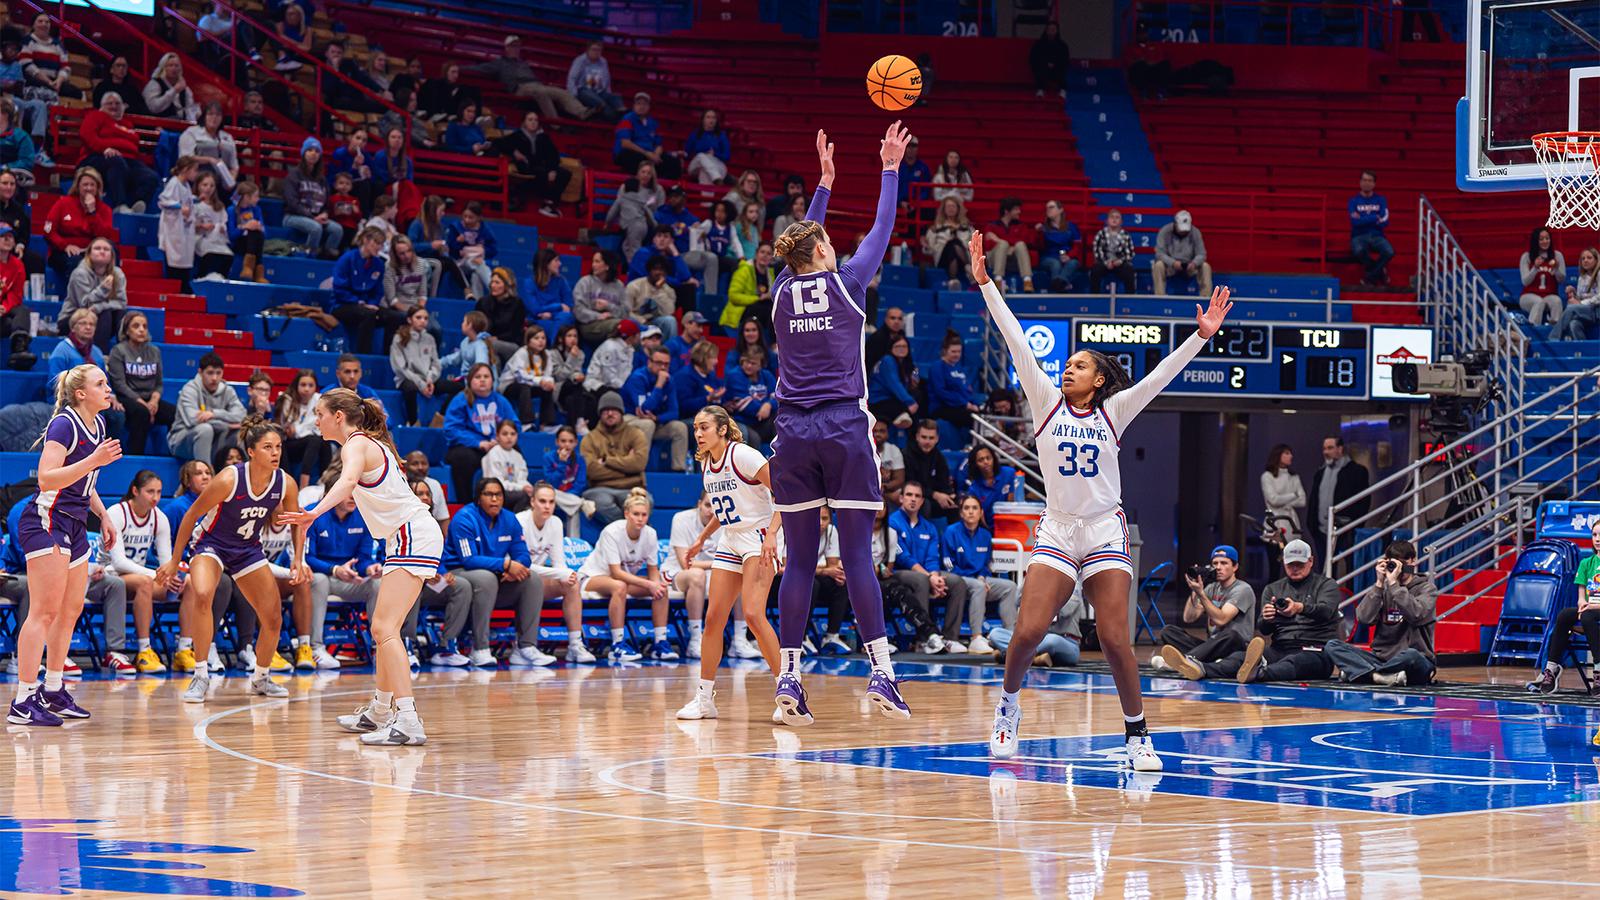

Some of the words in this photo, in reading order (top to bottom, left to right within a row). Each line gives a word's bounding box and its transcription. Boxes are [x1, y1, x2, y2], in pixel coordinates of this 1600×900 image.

[942, 21, 979, 38] 20A
[1105, 131, 1113, 141] 7
[1111, 150, 1120, 162] 6
[1119, 170, 1128, 182] 5
[1478, 168, 1508, 178] SPALDING
[1126, 193, 1134, 203] 4
[1134, 213, 1143, 225] 3
[1141, 235, 1150, 247] 2
[789, 277, 830, 315] 13
[789, 316, 834, 334] PRINCE
[1080, 323, 1162, 344] KANSAS
[1299, 329, 1341, 348] TCU
[1183, 370, 1225, 383] PERIOD
[1231, 366, 1245, 388] 2
[1328, 359, 1354, 386] 18
[1051, 423, 1108, 442] JAYHAWKS
[1057, 441, 1100, 478] 33
[240, 506, 268, 520] TCU
[711, 495, 742, 526] 22
[236, 519, 257, 540] 4
